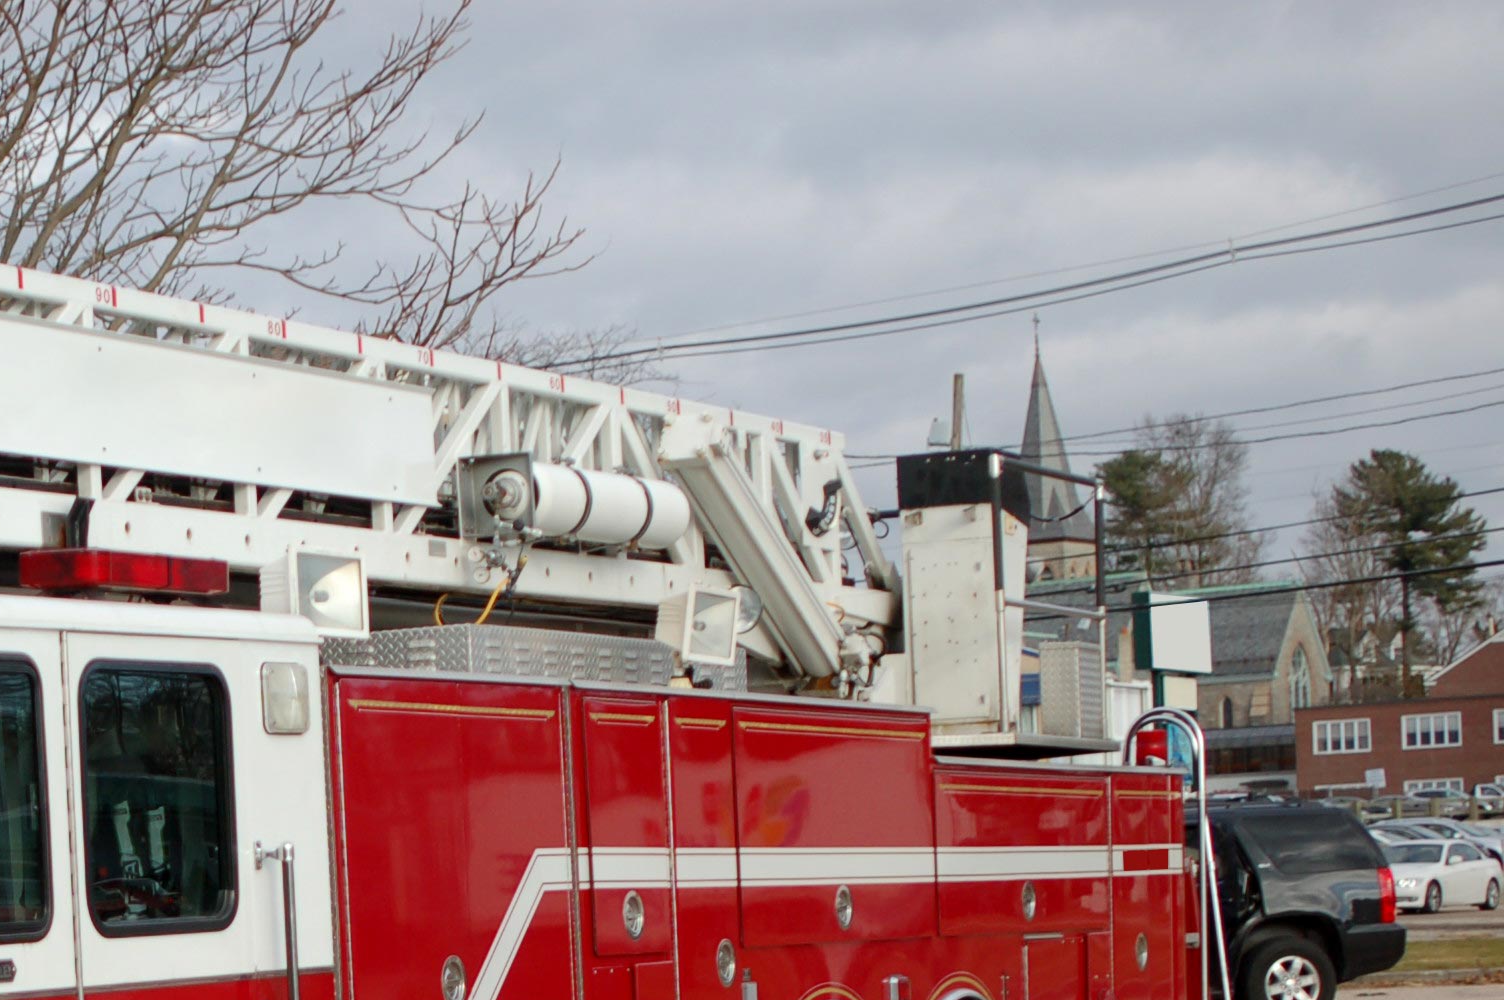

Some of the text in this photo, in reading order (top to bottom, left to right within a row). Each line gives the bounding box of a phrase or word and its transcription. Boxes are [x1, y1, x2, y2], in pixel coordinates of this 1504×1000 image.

[96, 287, 110, 304] 90
[267, 320, 281, 336] 80
[417, 349, 429, 365] 70
[549, 376, 561, 390] 60
